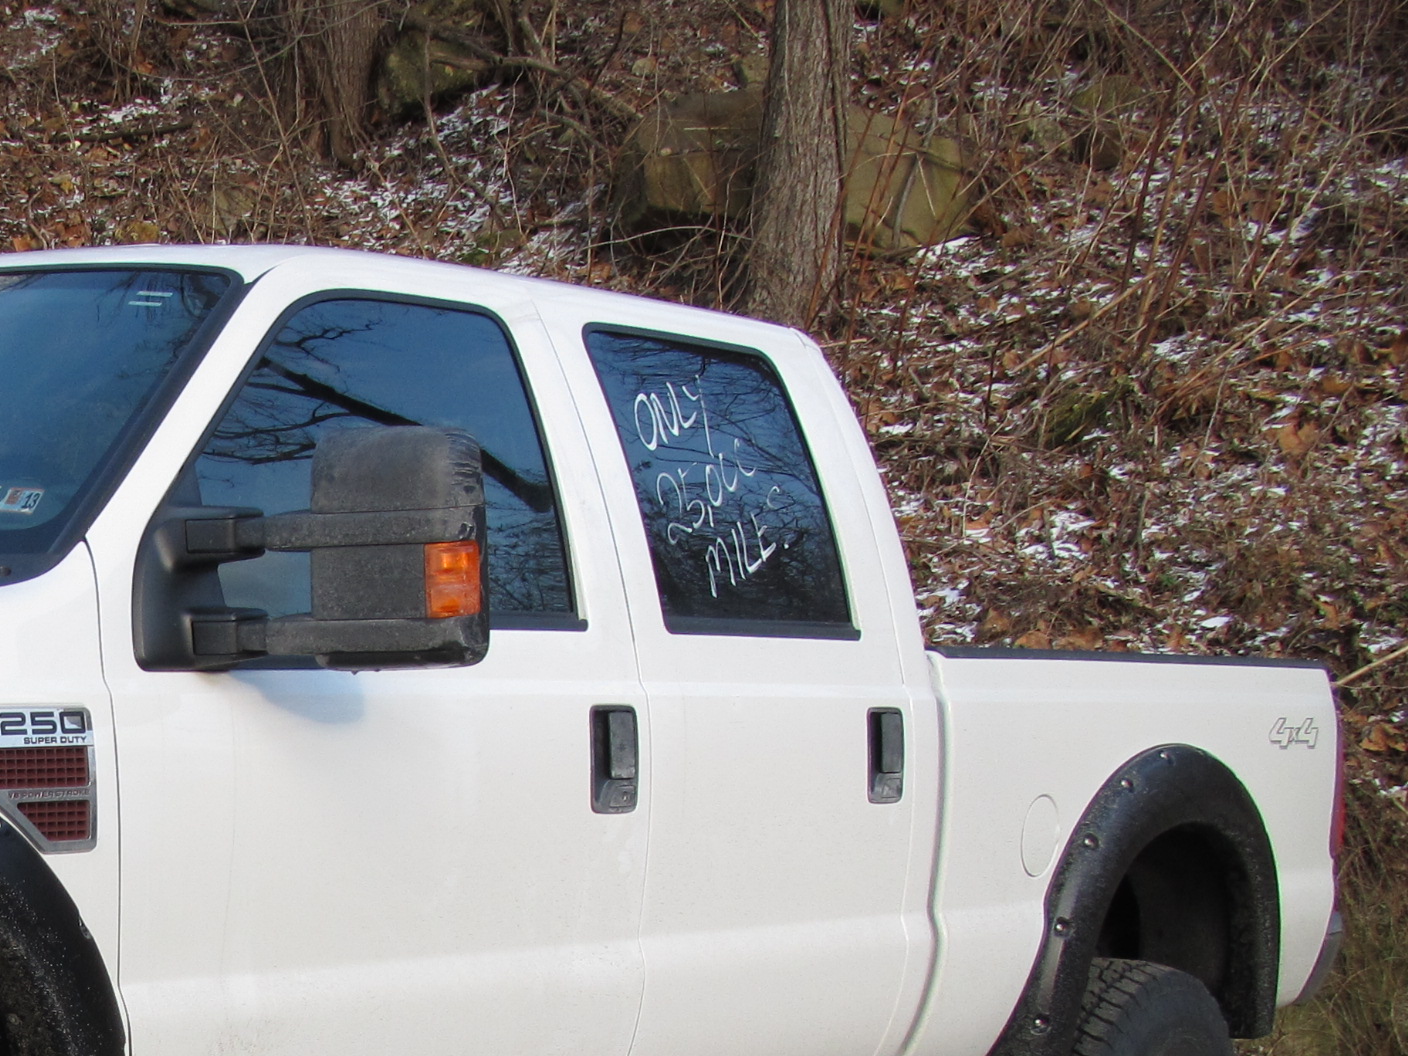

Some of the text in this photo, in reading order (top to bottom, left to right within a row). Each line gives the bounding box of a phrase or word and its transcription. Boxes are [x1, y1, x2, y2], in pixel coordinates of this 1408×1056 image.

[632, 374, 716, 459] ONLY
[21, 491, 41, 509] 13
[23, 736, 87, 745] SUPER DUTY
